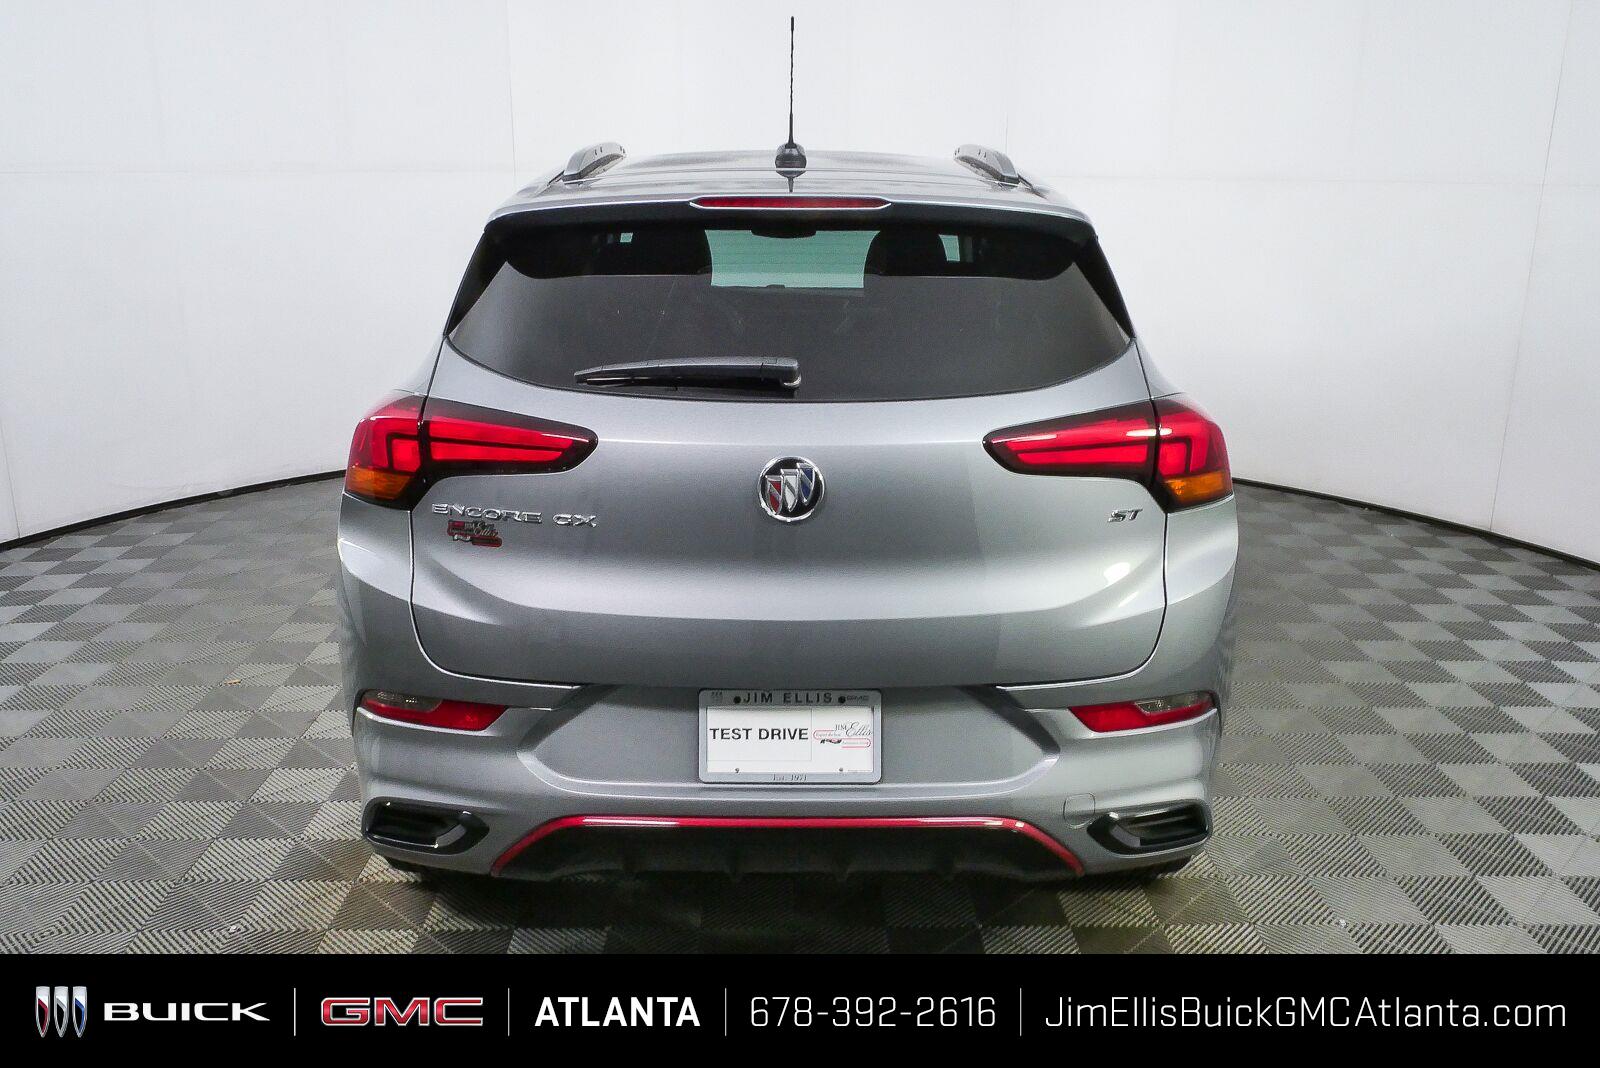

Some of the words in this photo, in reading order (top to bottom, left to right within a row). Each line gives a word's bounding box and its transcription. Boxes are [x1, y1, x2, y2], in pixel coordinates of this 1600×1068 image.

[432, 503, 543, 524] ENCORE
[553, 513, 598, 528] GX
[1107, 509, 1143, 522] ST
[743, 692, 773, 704] JIM
[783, 692, 833, 704] ELLIS
[709, 728, 752, 740] TEST
[758, 728, 809, 740] DRIVE
